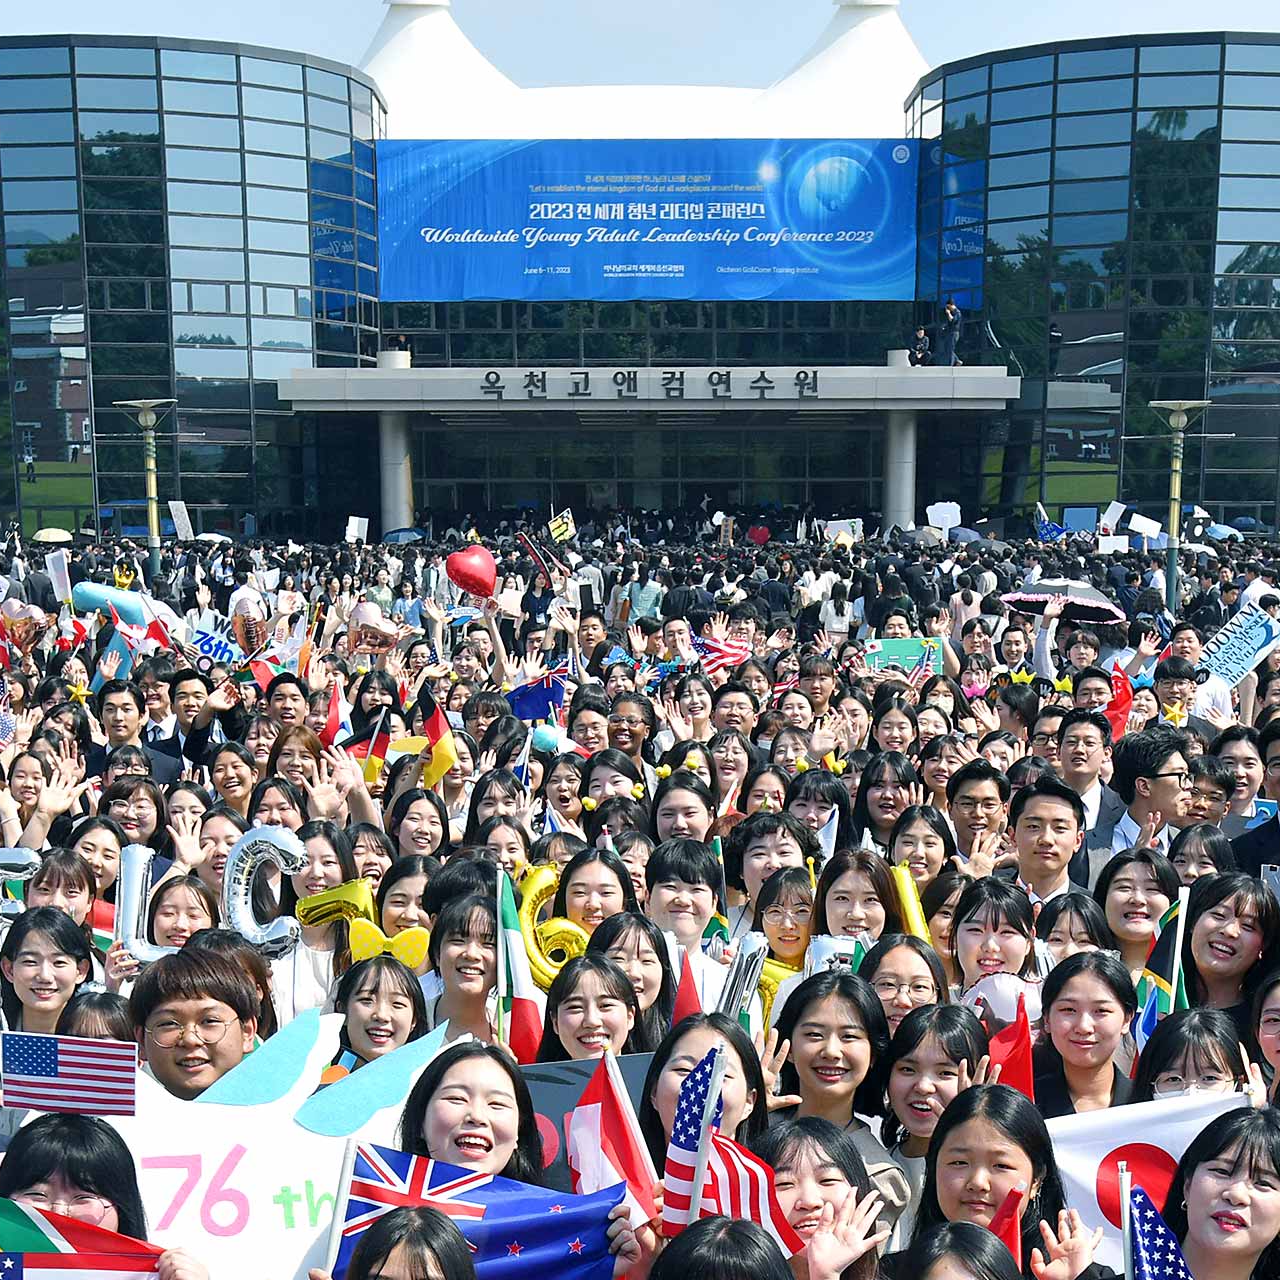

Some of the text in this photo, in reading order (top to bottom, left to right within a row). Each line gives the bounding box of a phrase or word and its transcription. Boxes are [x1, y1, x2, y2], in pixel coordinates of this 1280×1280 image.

[529, 202, 572, 220] 2023
[419, 226, 875, 249] Worldwide Young Adult Leadership Conference 2023
[480, 370, 820, 400] 옥천고앤컴연수원
[192, 629, 234, 665] 76th
[140, 1142, 251, 1237] 76
